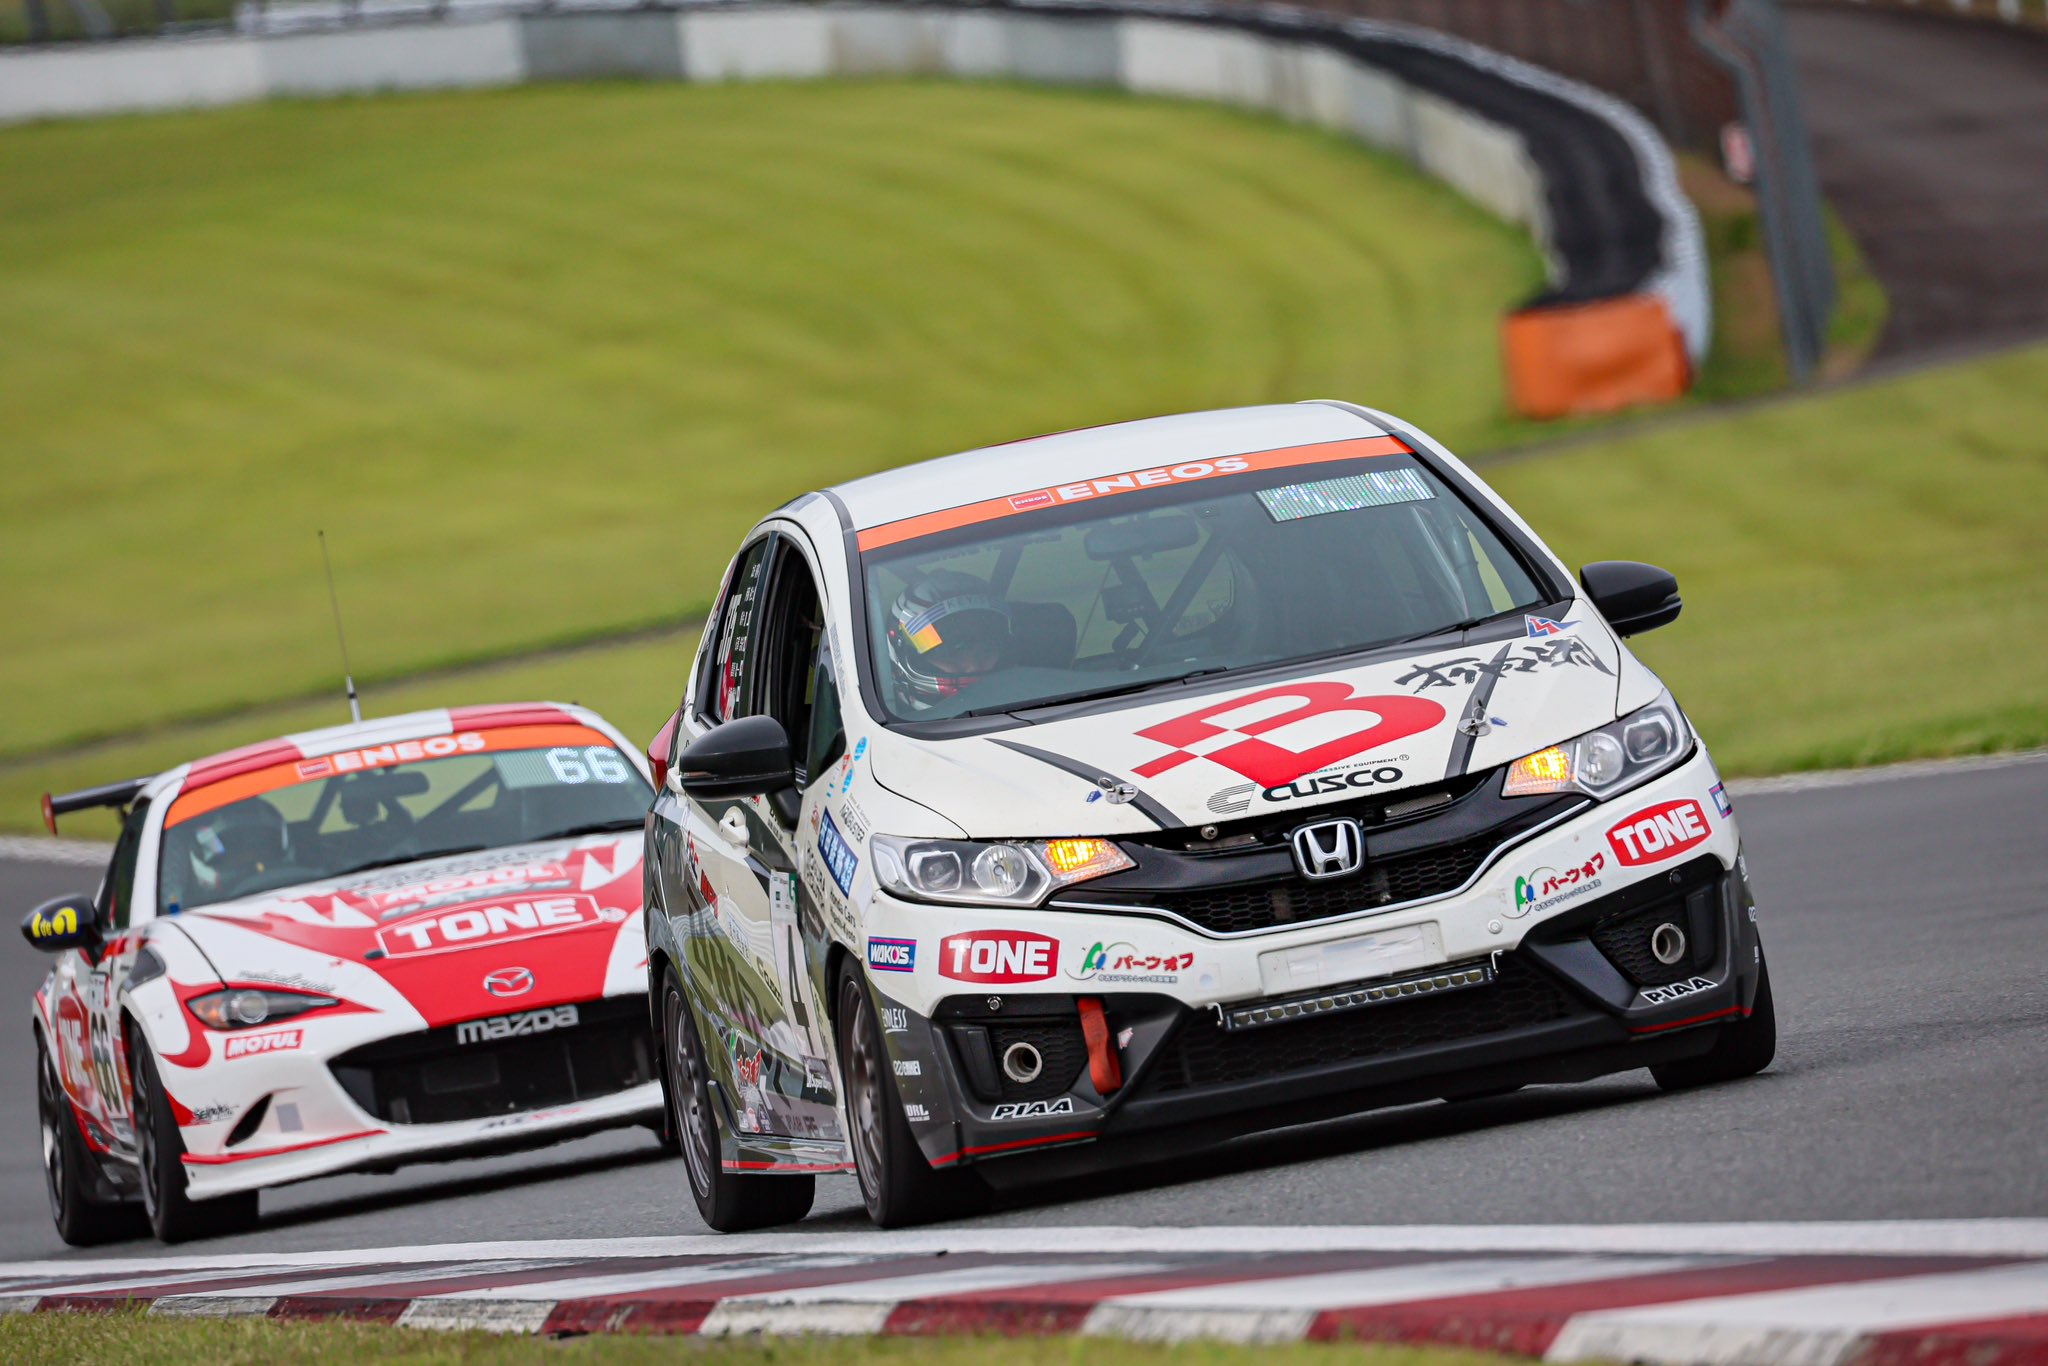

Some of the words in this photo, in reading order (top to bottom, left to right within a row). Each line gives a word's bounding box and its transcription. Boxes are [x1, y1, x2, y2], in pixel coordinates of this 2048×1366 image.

[1057, 458, 1249, 500] ENEOS
[1014, 494, 1048, 504] ENEOS
[335, 732, 486, 772] ENEOS
[545, 746, 628, 784] 66
[1354, 757, 1398, 768] EQUIPMENT
[1262, 767, 1403, 802] CUSCO
[1612, 803, 1706, 860] TONE
[385, 867, 554, 903] MOTUL
[395, 897, 584, 949] TONE
[949, 940, 1049, 975] TONE
[786, 924, 816, 1058] 4
[1641, 976, 1718, 1004] PIAA
[230, 1035, 301, 1055] MOTUL
[992, 1098, 1073, 1119] PIAA
